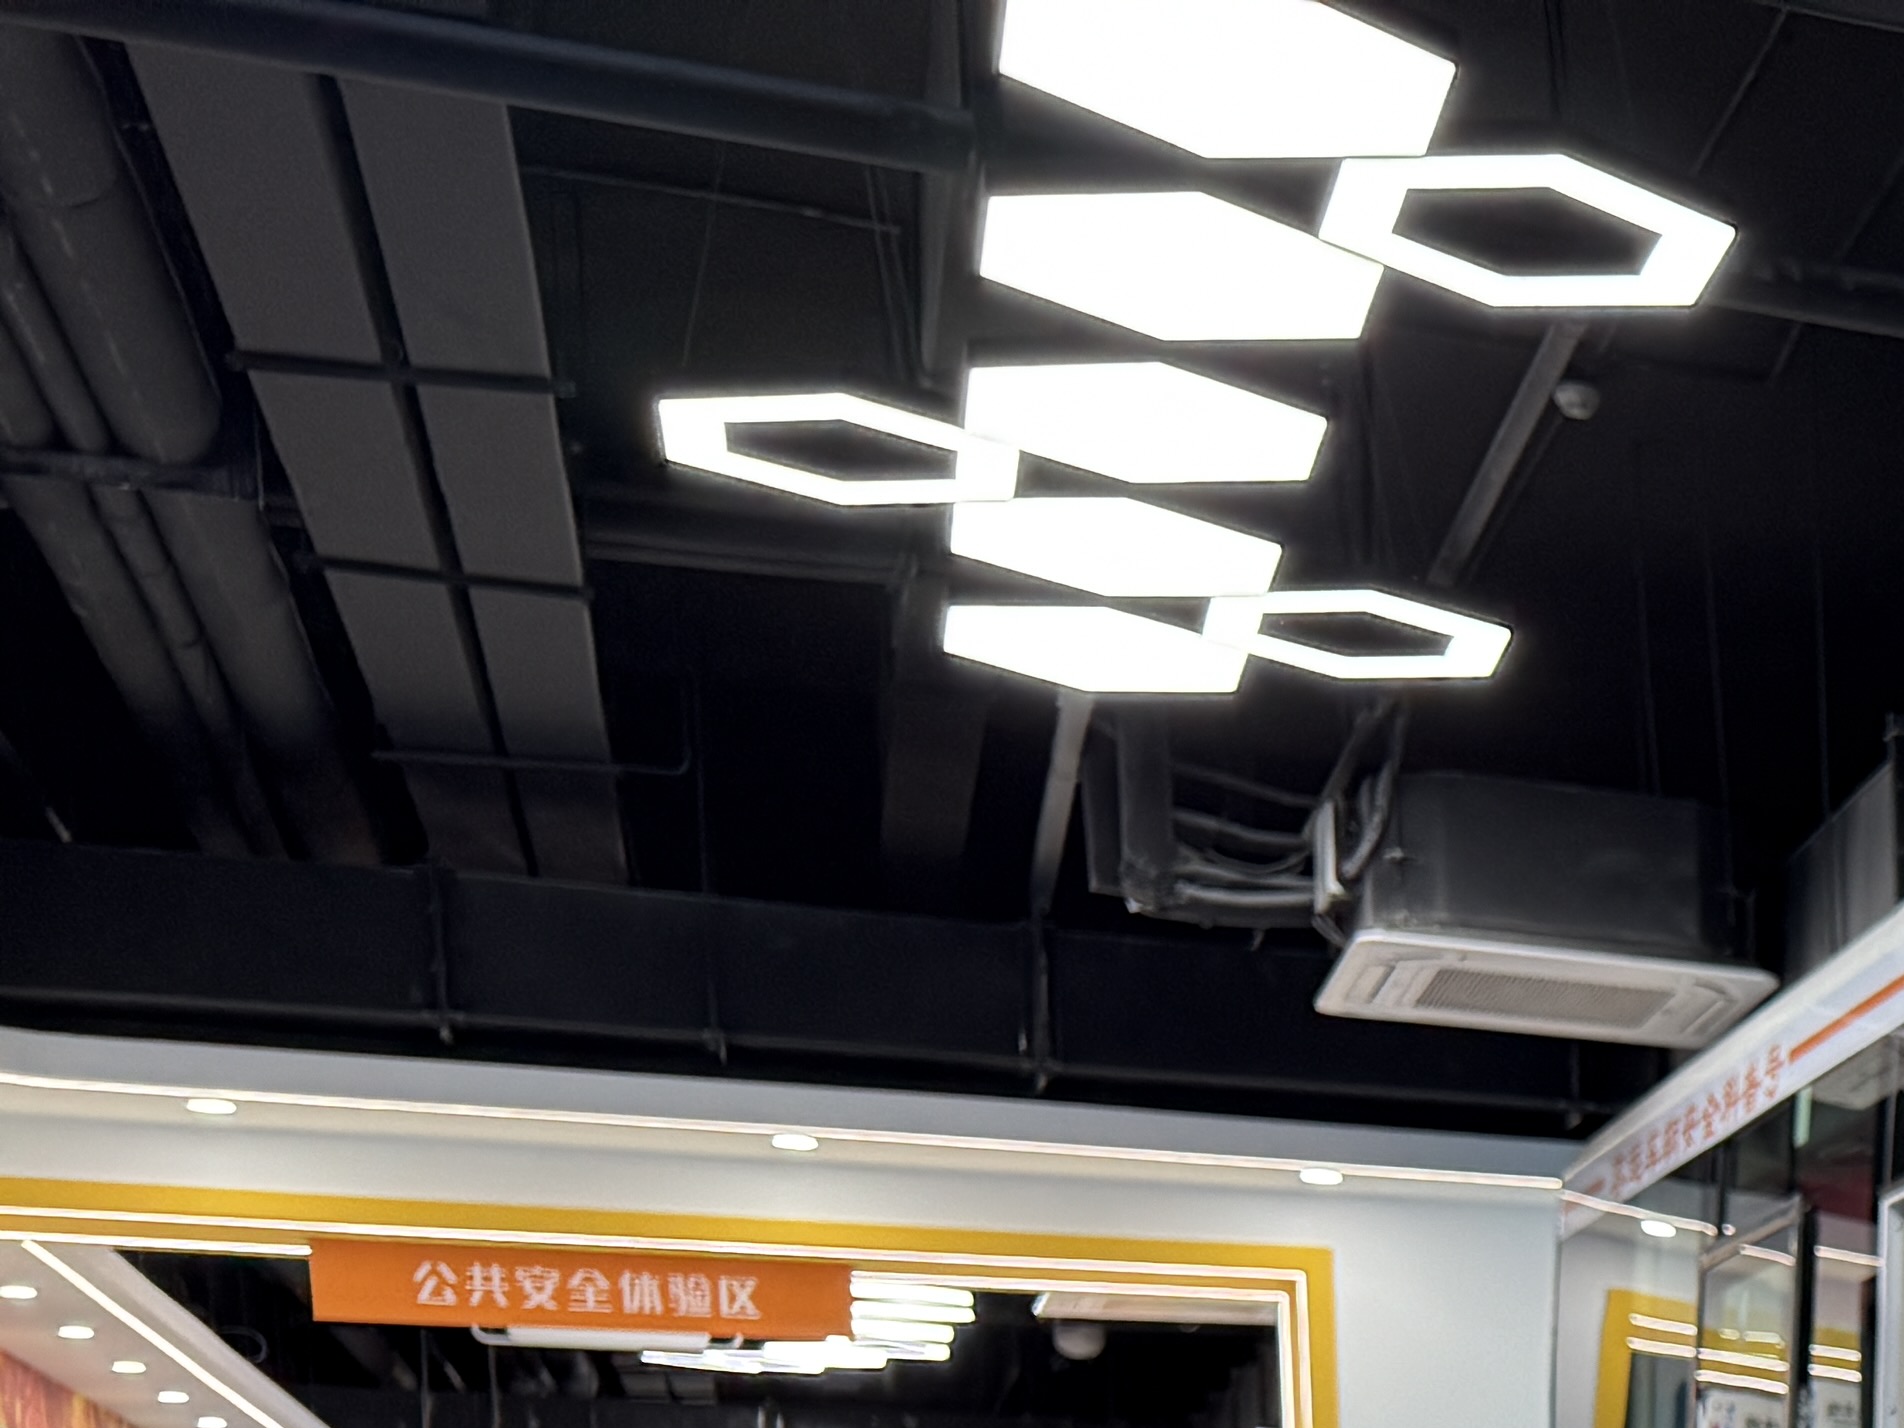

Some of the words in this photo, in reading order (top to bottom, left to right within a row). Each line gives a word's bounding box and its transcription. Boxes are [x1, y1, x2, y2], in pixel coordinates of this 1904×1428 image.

[412, 1260, 762, 1320] 公共安全体验区
